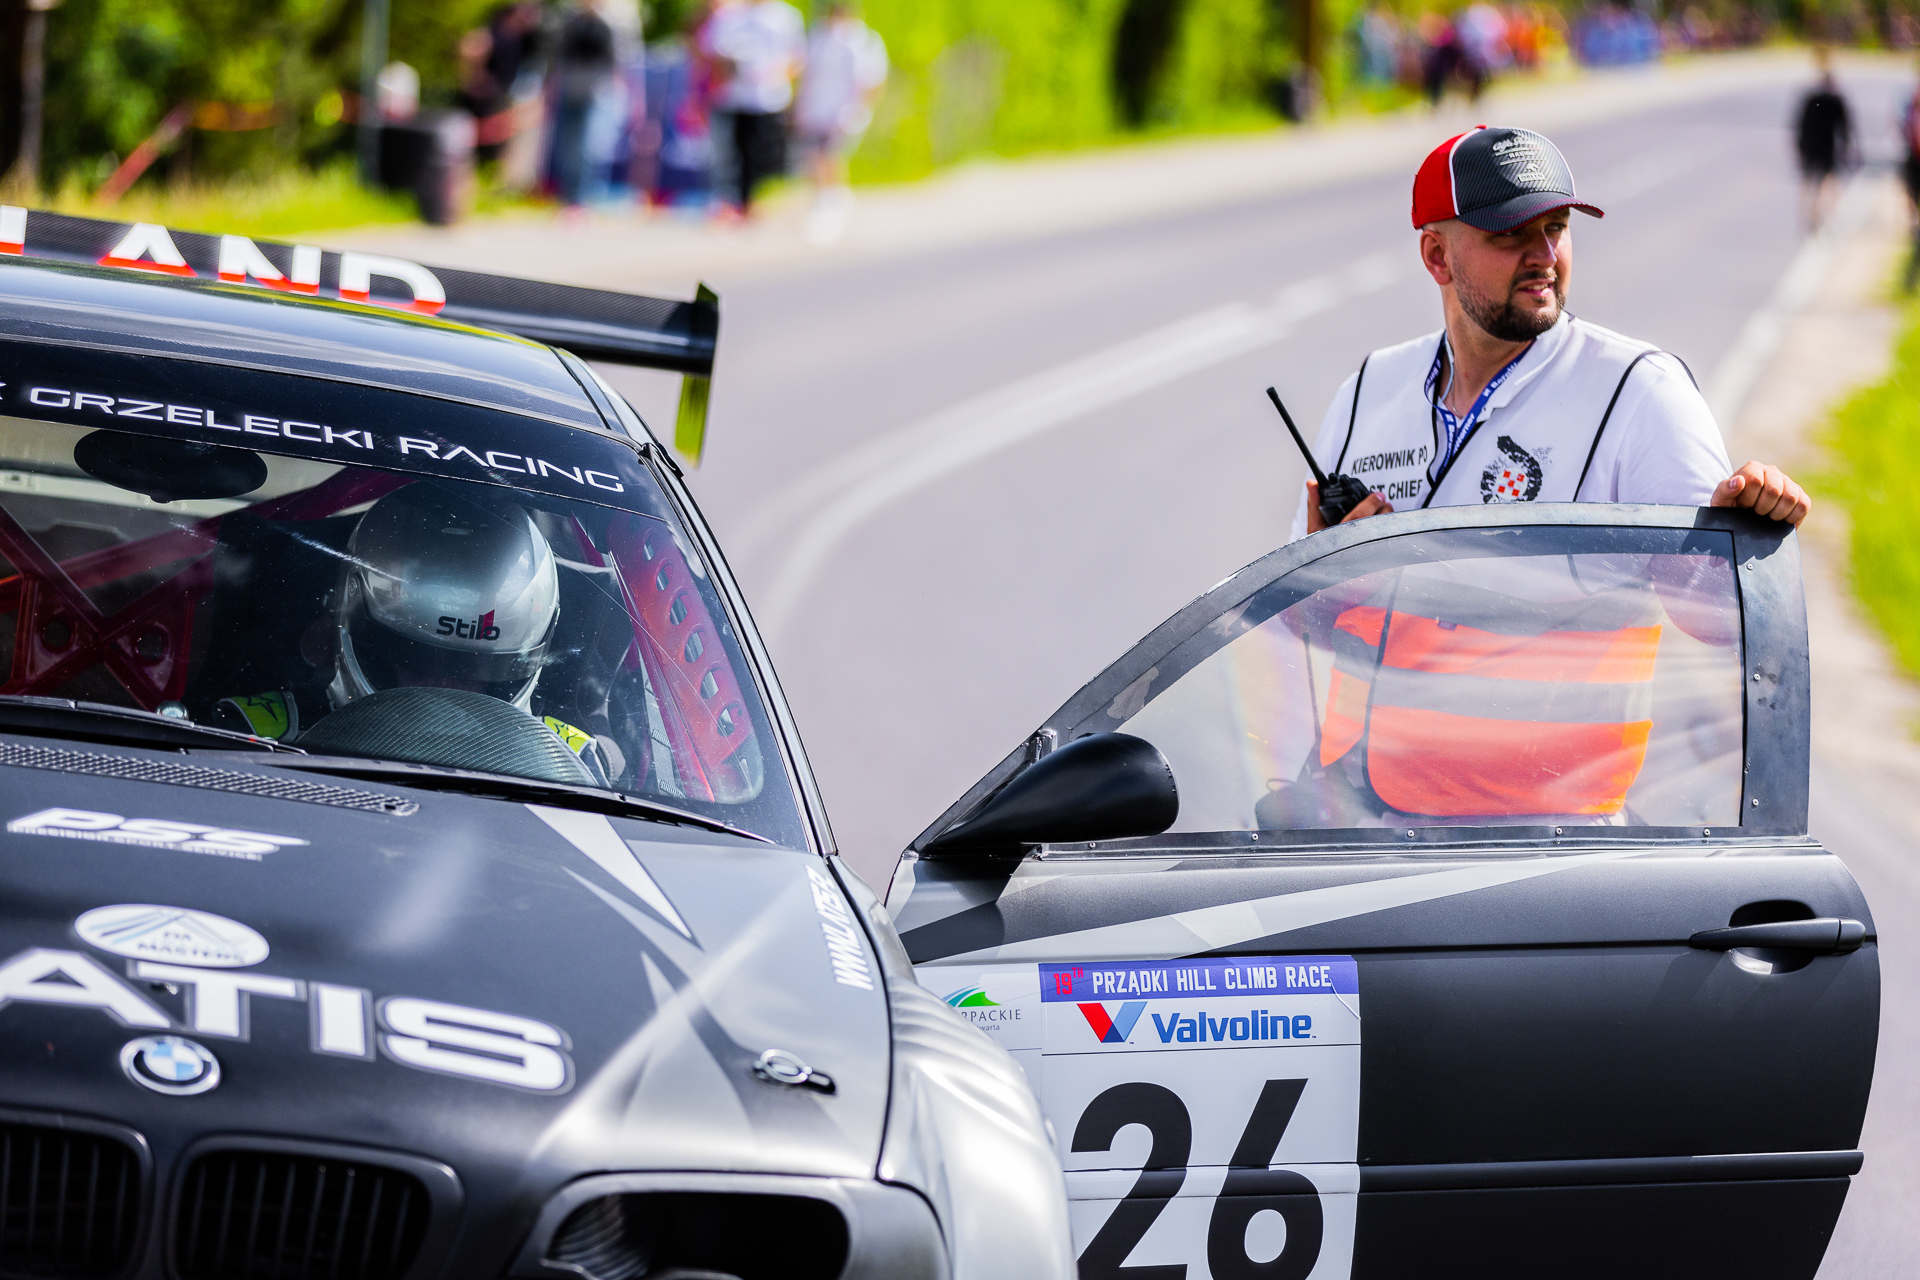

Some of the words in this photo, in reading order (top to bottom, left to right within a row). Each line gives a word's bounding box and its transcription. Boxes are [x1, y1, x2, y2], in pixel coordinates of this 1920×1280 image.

[30, 386, 375, 451] GRZELECKI
[399, 436, 624, 493] RACING
[1351, 449, 1416, 475] KIEROWNIK
[1388, 479, 1423, 500] CHIEF
[436, 609, 501, 641] Stilo
[7, 807, 310, 855] PSS
[1092, 969, 1169, 996] PRZĄDKI
[1176, 968, 1217, 992] HILL
[1224, 966, 1278, 990] CLIMB
[1285, 965, 1332, 988] RACE
[1151, 1010, 1312, 1042] Valvoline
[1071, 1078, 1324, 1280] 26
